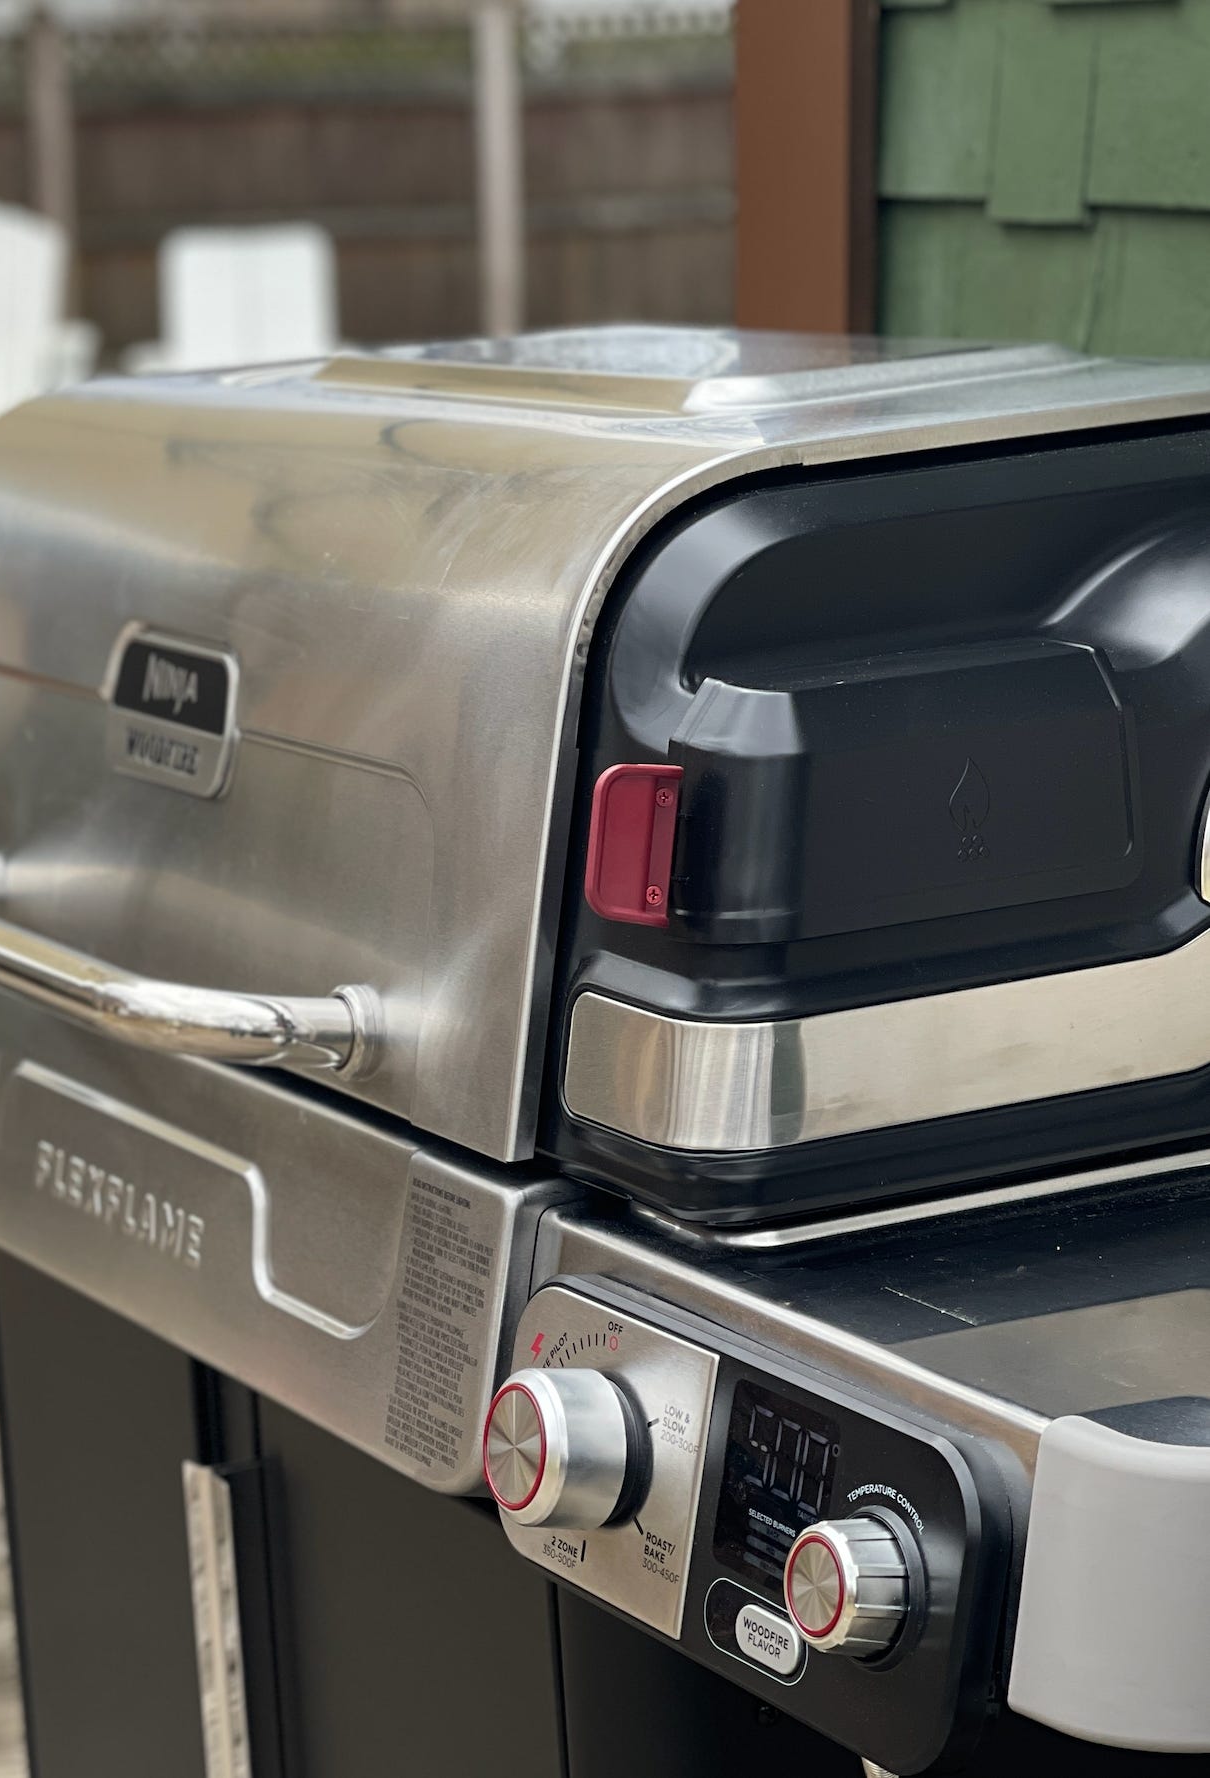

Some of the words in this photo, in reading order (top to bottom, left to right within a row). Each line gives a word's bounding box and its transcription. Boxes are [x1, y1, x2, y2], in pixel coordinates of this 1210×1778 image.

[35, 1138, 205, 1267] FLEXFLAME
[608, 1321, 624, 1335] OFF
[550, 1332, 569, 1359] PILOT
[662, 1416, 687, 1436] SLOW
[664, 1403, 684, 1420] LOW
[684, 1412, 690, 1424] &
[846, 1483, 897, 1503] TEMPERATURE
[896, 1493, 925, 1536] CONTROL
[748, 1507, 774, 1526] SELECTED
[773, 1520, 797, 1539] BURNERS
[542, 1543, 578, 1569] 350-500F
[551, 1535, 557, 1546] 2
[557, 1538, 579, 1559] ZONE
[644, 1544, 666, 1564] BAKE
[645, 1531, 677, 1556] ROAST/
[642, 1557, 680, 1585] 300-450F
[743, 1616, 789, 1650] WOODFIRE
[748, 1632, 781, 1660] FLAVOR
